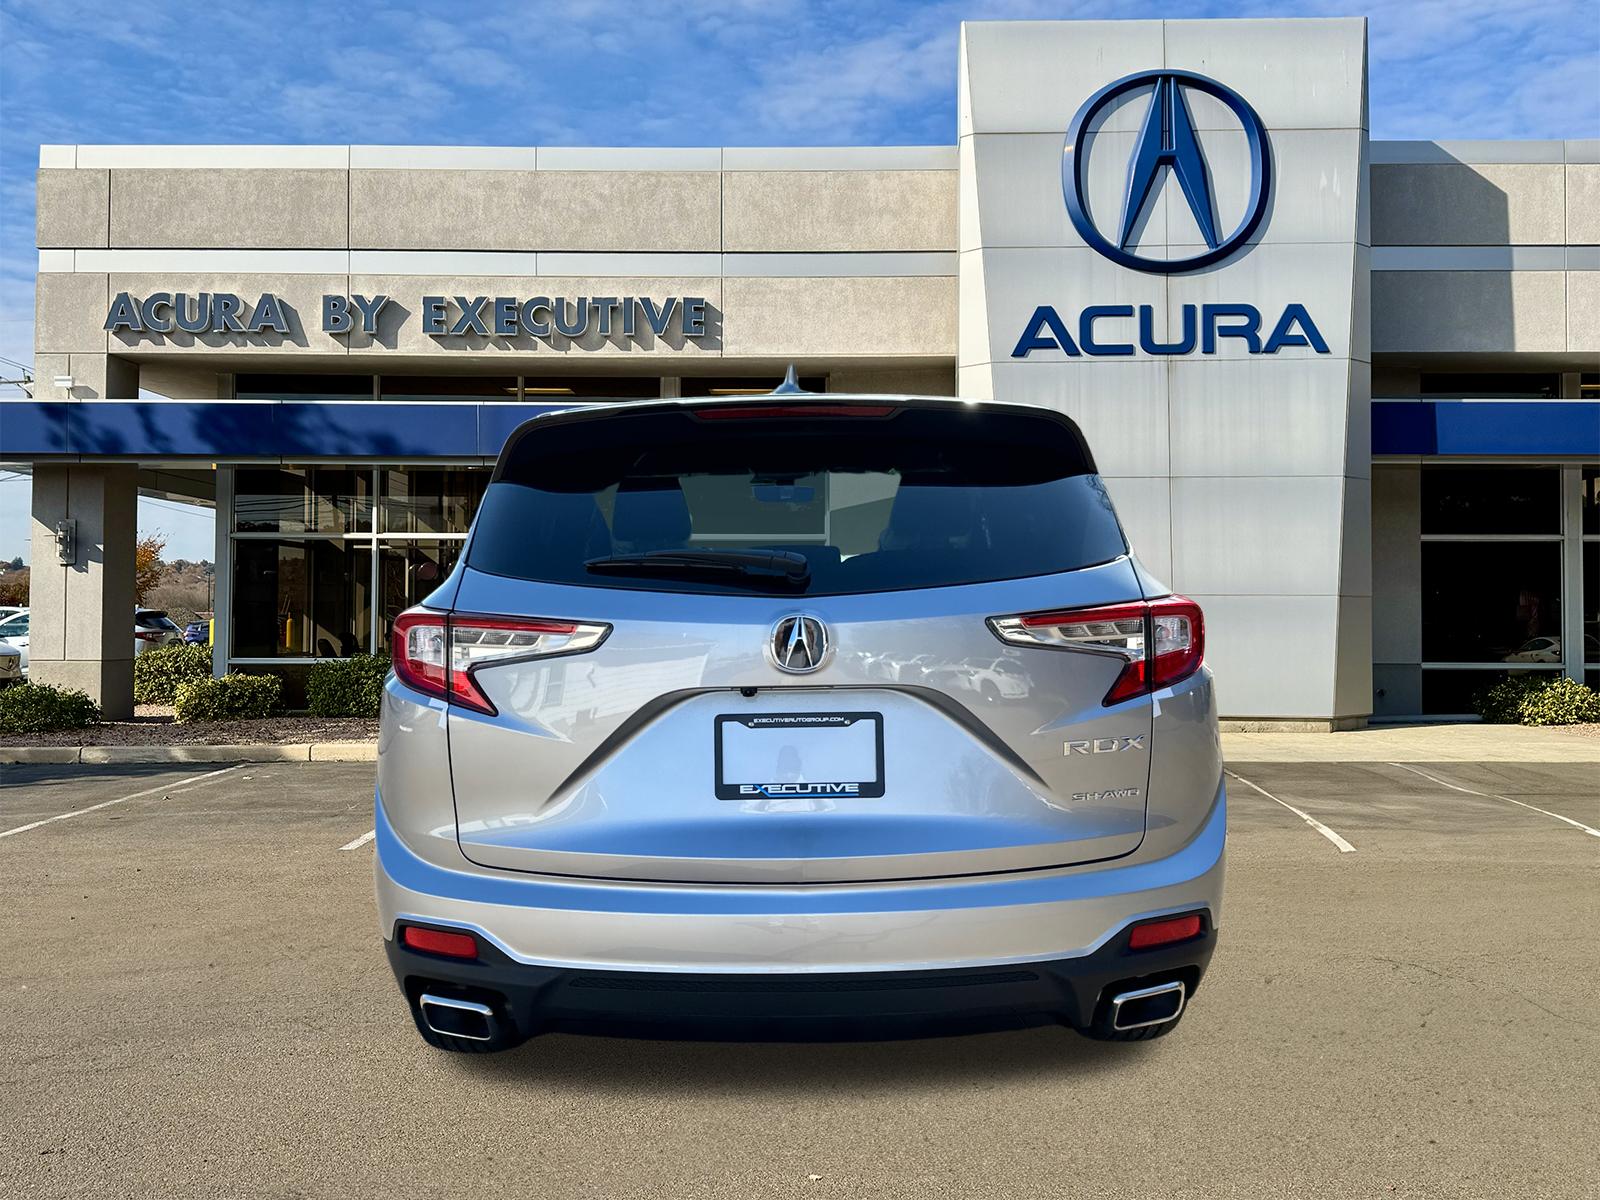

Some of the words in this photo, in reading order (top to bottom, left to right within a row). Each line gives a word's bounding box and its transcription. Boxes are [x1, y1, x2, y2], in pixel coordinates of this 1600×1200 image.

[103, 291, 290, 334] ACURA
[321, 294, 391, 335] BY
[422, 295, 708, 337] EXECUTIVE
[1011, 303, 1332, 358] ACURA
[1063, 734, 1144, 756] RDX
[739, 783, 860, 795] EXECUTIVE
